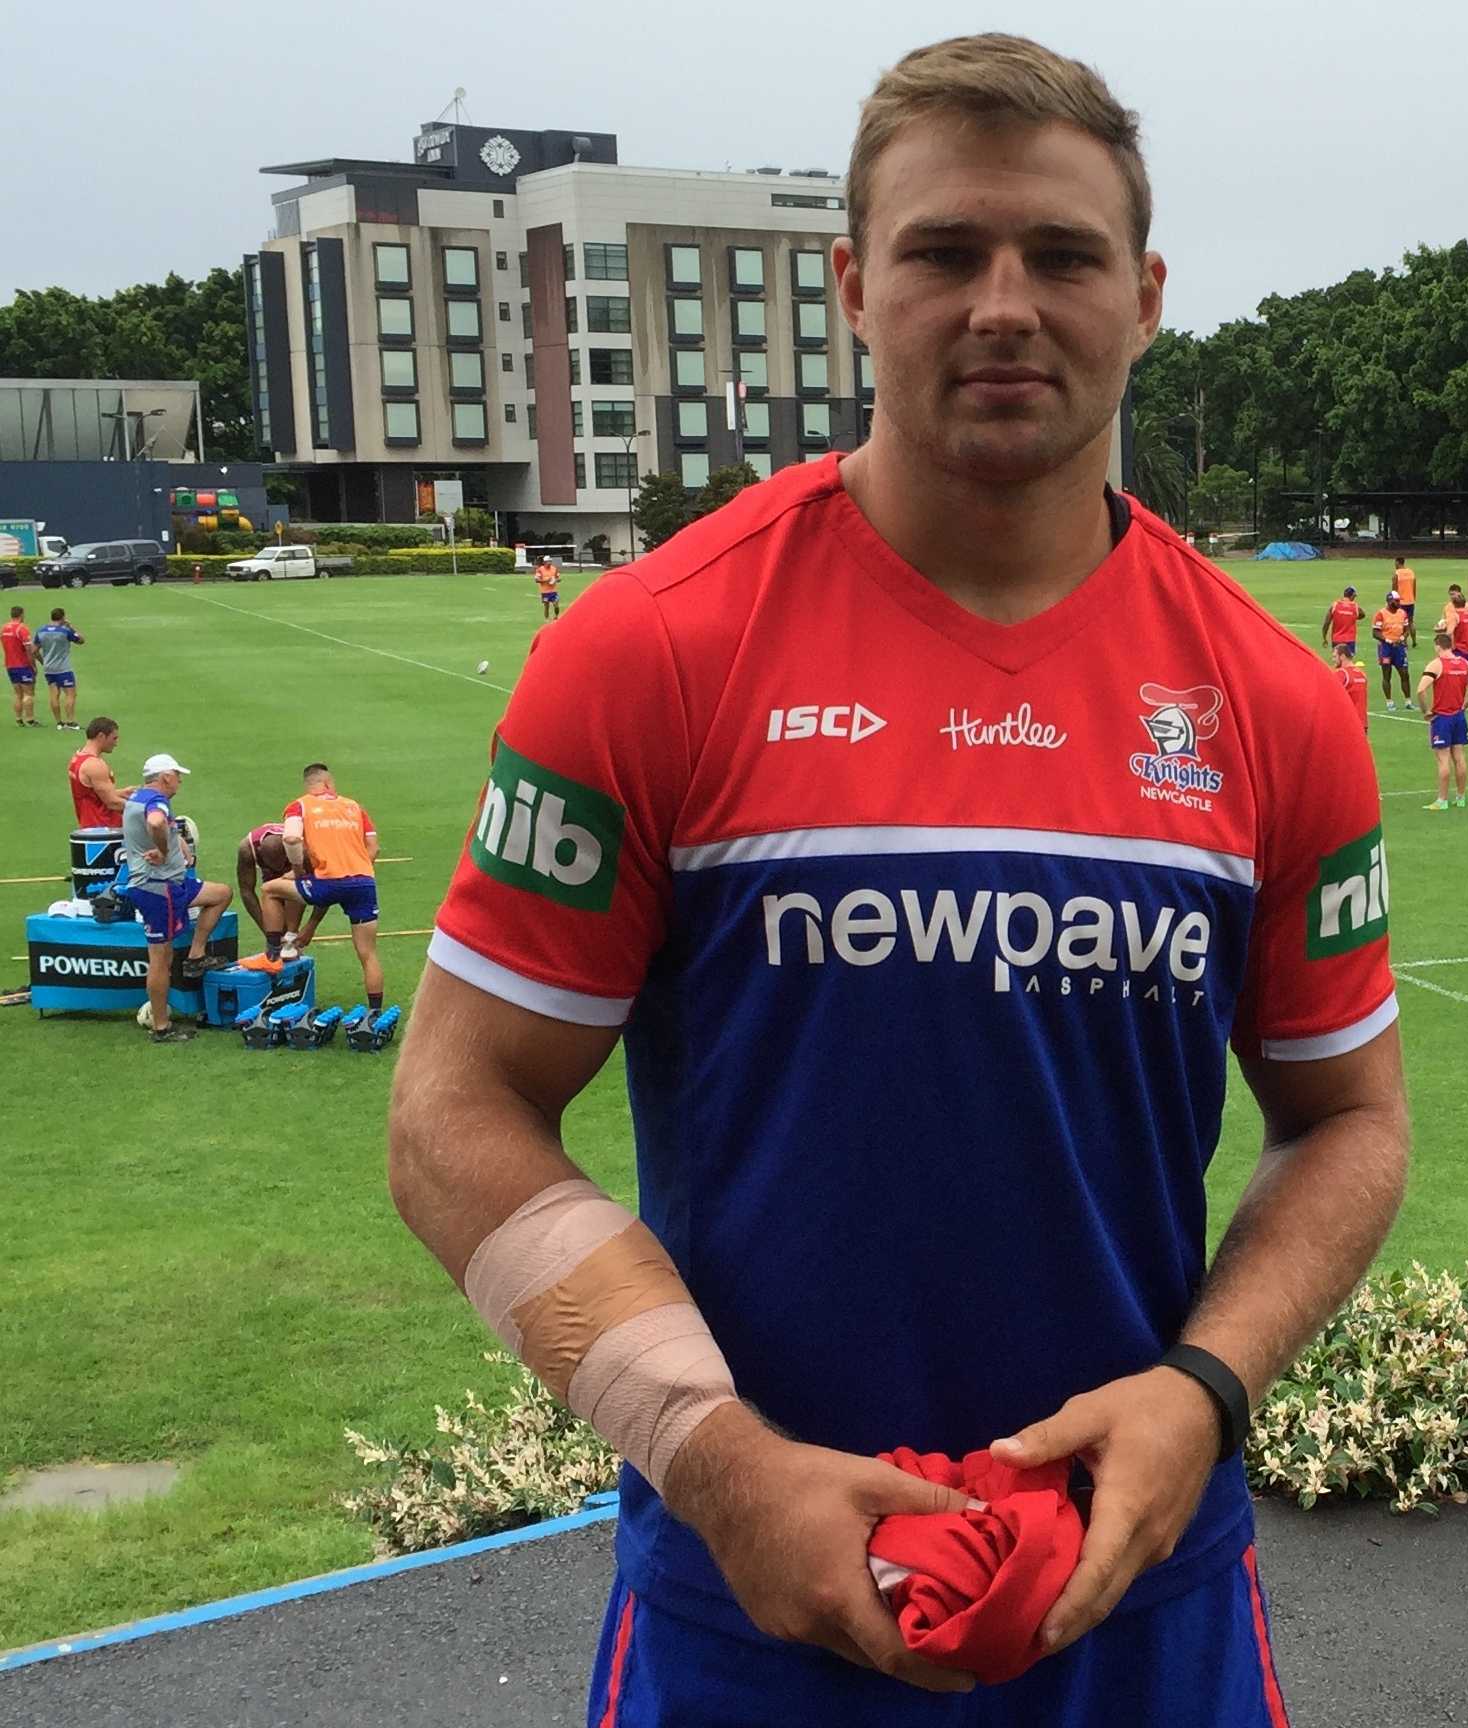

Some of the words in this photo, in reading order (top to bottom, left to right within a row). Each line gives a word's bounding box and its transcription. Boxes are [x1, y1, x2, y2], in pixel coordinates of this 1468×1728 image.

[939, 702, 1067, 750] Huntlee
[1130, 753, 1223, 792] Knights
[1140, 787, 1212, 811] NEWCASTLE
[477, 778, 602, 886] nib
[762, 888, 1210, 992] newpave
[39, 955, 150, 977] POWERAD
[1025, 975, 1204, 1006] ASPHALT
